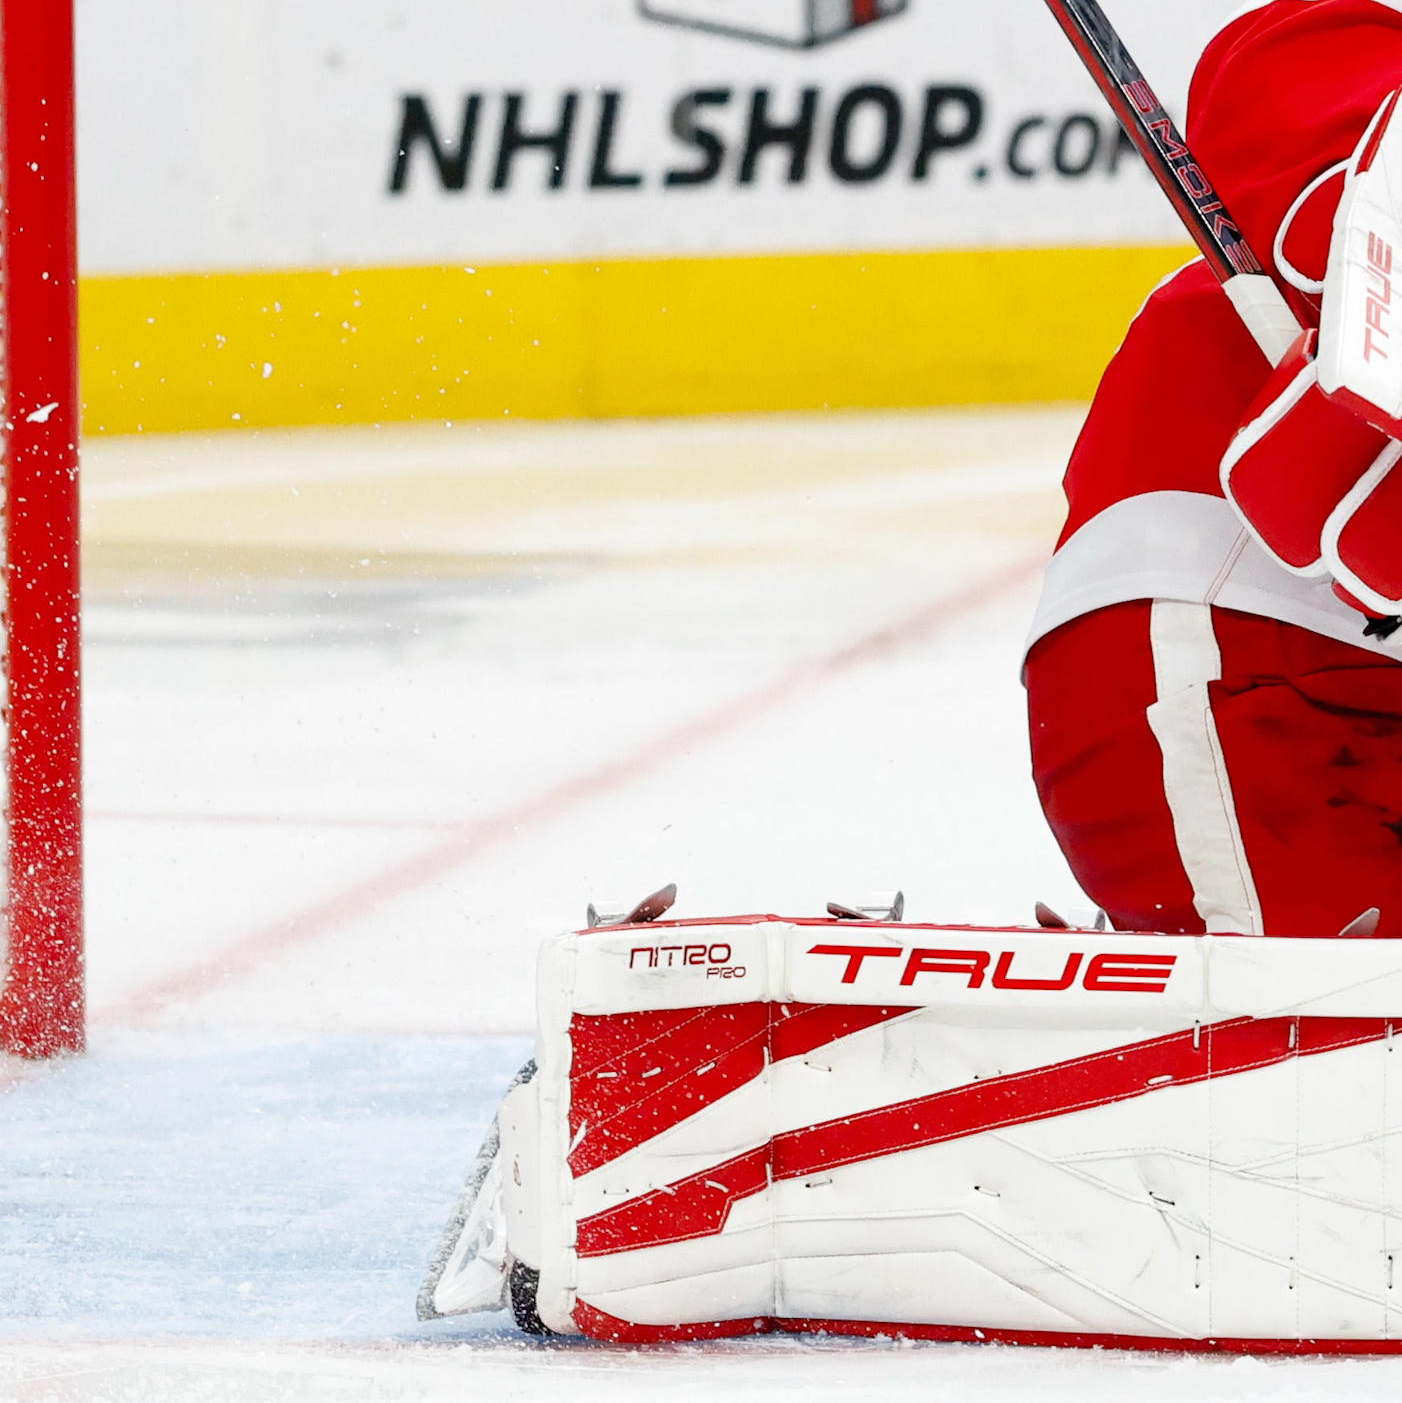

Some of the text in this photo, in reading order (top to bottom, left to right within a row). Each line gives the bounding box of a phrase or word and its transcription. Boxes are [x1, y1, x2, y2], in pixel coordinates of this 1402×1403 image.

[1123, 78, 1262, 275] SMOKE
[1363, 230, 1395, 365] TRUE
[628, 943, 732, 969] NITRO
[706, 966, 747, 980] PRO
[805, 943, 1178, 994] TRUE
